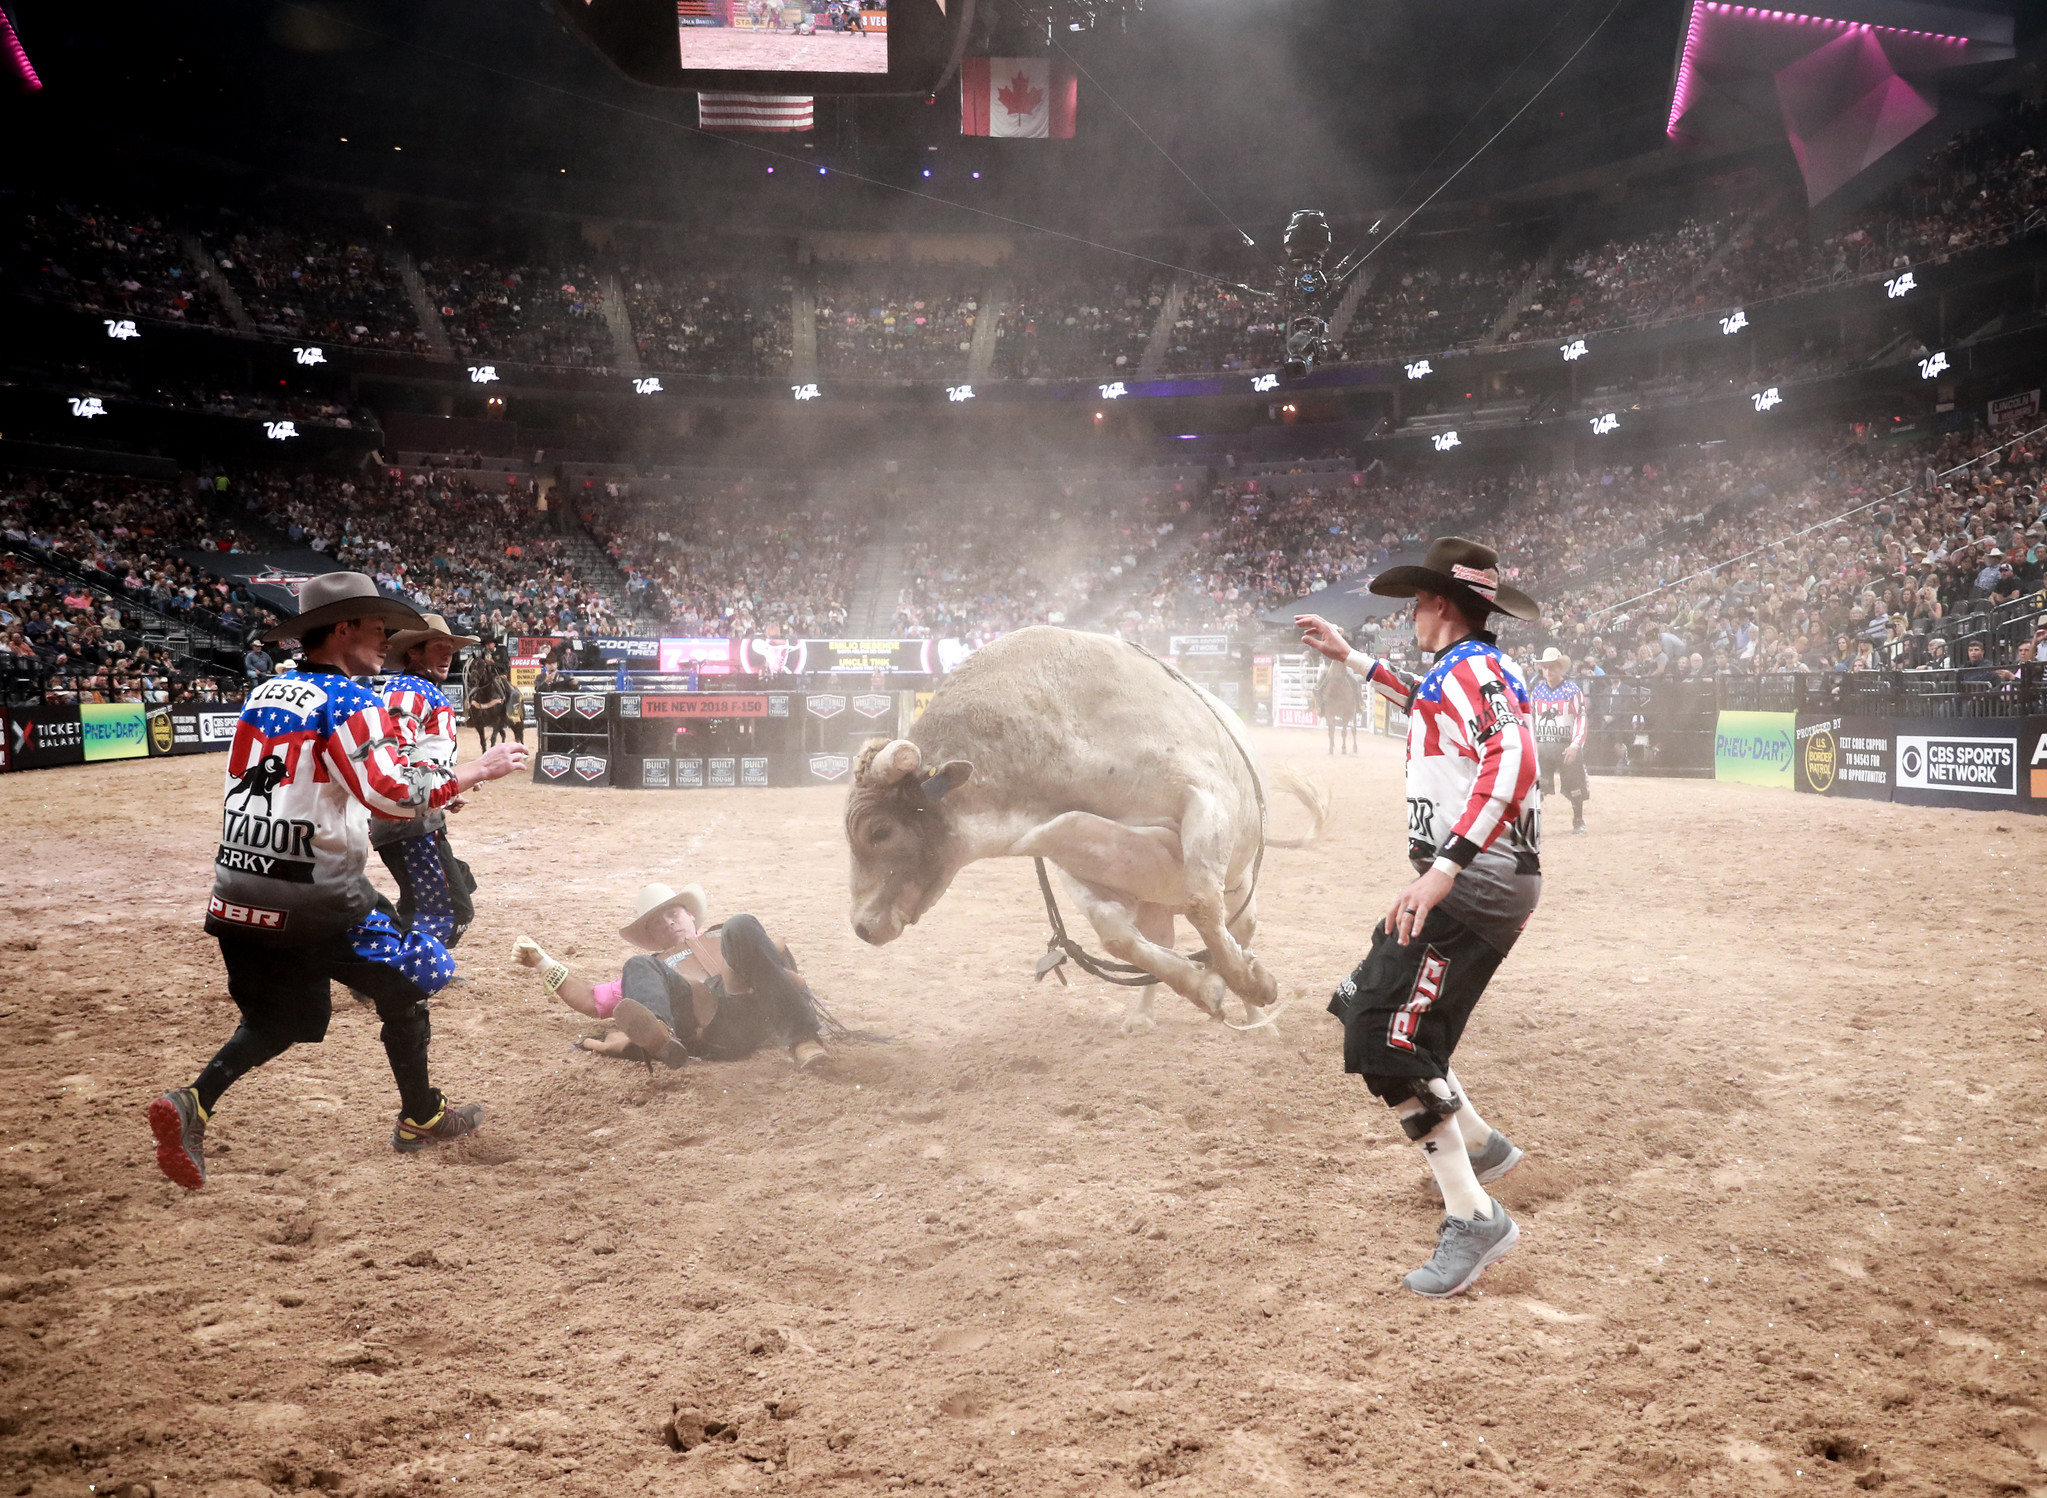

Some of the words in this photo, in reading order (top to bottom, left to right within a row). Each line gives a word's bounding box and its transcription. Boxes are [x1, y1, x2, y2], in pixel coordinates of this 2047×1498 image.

[597, 640, 659, 650] COOPER
[254, 683, 315, 708] JESSE
[646, 701, 668, 712] THE
[671, 701, 698, 712] NEW
[701, 701, 728, 712] 2018
[731, 701, 762, 712] F-150
[37, 722, 81, 736] TICKET
[214, 727, 236, 736] NETWO
[1490, 714, 1524, 736] JERKY
[1796, 721, 1832, 739] PROTECTED
[1832, 718, 1842, 730] BY
[39, 737, 81, 748] GALAXY
[1839, 737, 1851, 749] TEXT
[1809, 751, 1832, 763] BORDER
[1846, 753, 1853, 765] TO
[1870, 754, 1880, 767] FOR
[1929, 746, 1953, 764] CBS
[1955, 747, 2011, 766] SPORTS
[646, 761, 666, 769] BUILT
[678, 761, 699, 769] BUILT
[711, 761, 732, 769] BUILT
[744, 761, 764, 769] BUILT
[1838, 768, 1847, 780] JOB
[1848, 769, 1887, 784] OPPORTUNITIES
[1929, 764, 1997, 784] NETWORK
[224, 809, 315, 858] TADOR
[220, 848, 275, 874] ERKY
[209, 895, 281, 927] PBR
